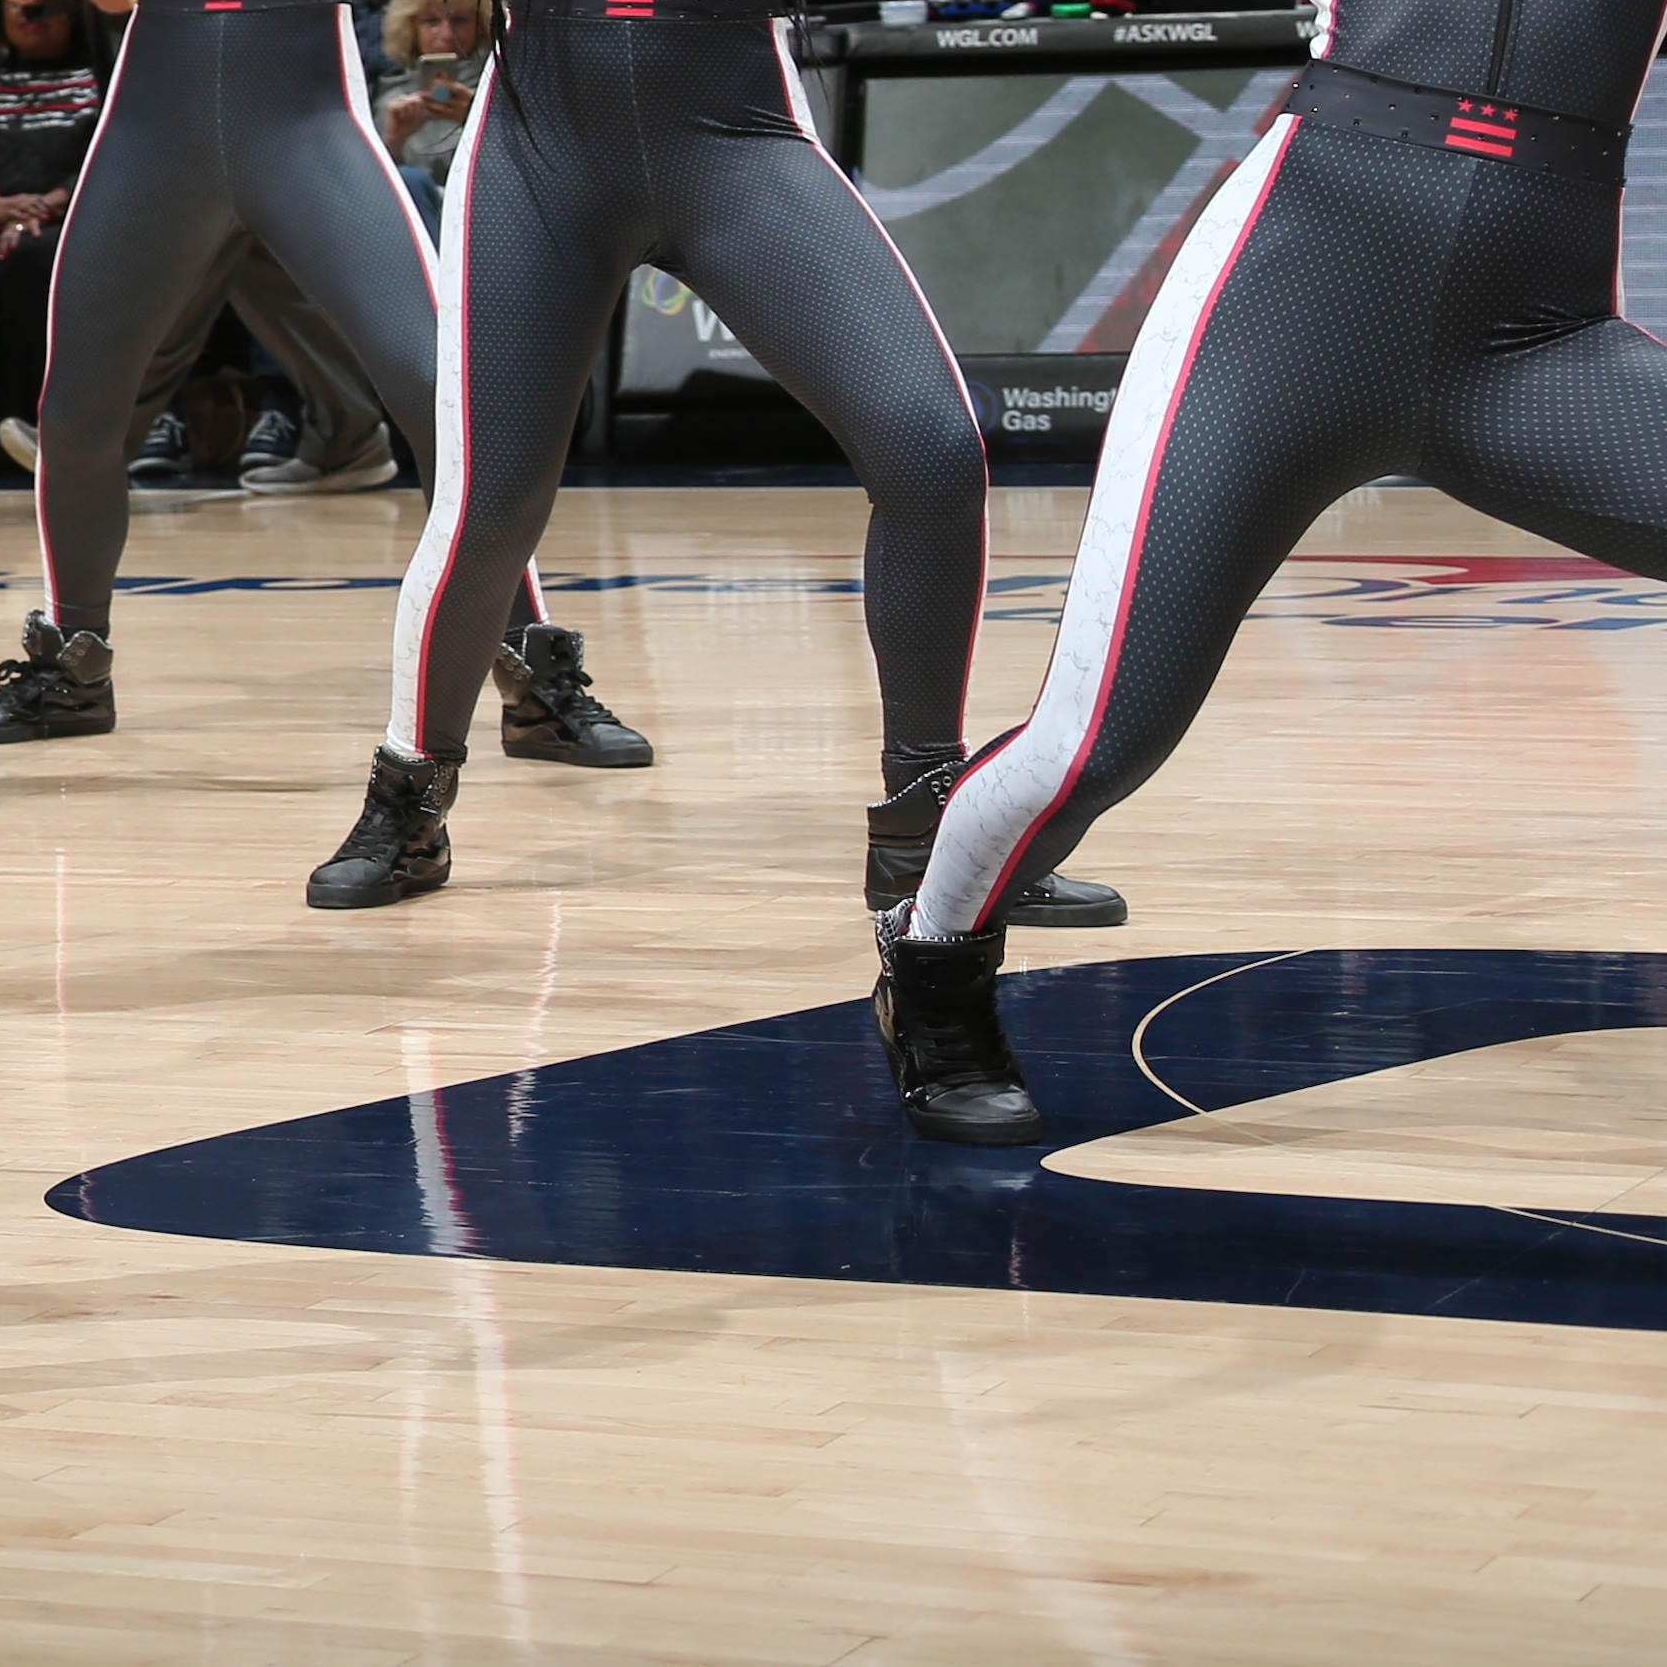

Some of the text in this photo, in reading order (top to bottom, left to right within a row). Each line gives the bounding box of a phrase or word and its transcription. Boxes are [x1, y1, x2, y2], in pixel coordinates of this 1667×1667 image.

[936, 22, 1219, 49] WGL.COM #ASKWGL
[1001, 410, 1052, 432] Gas
